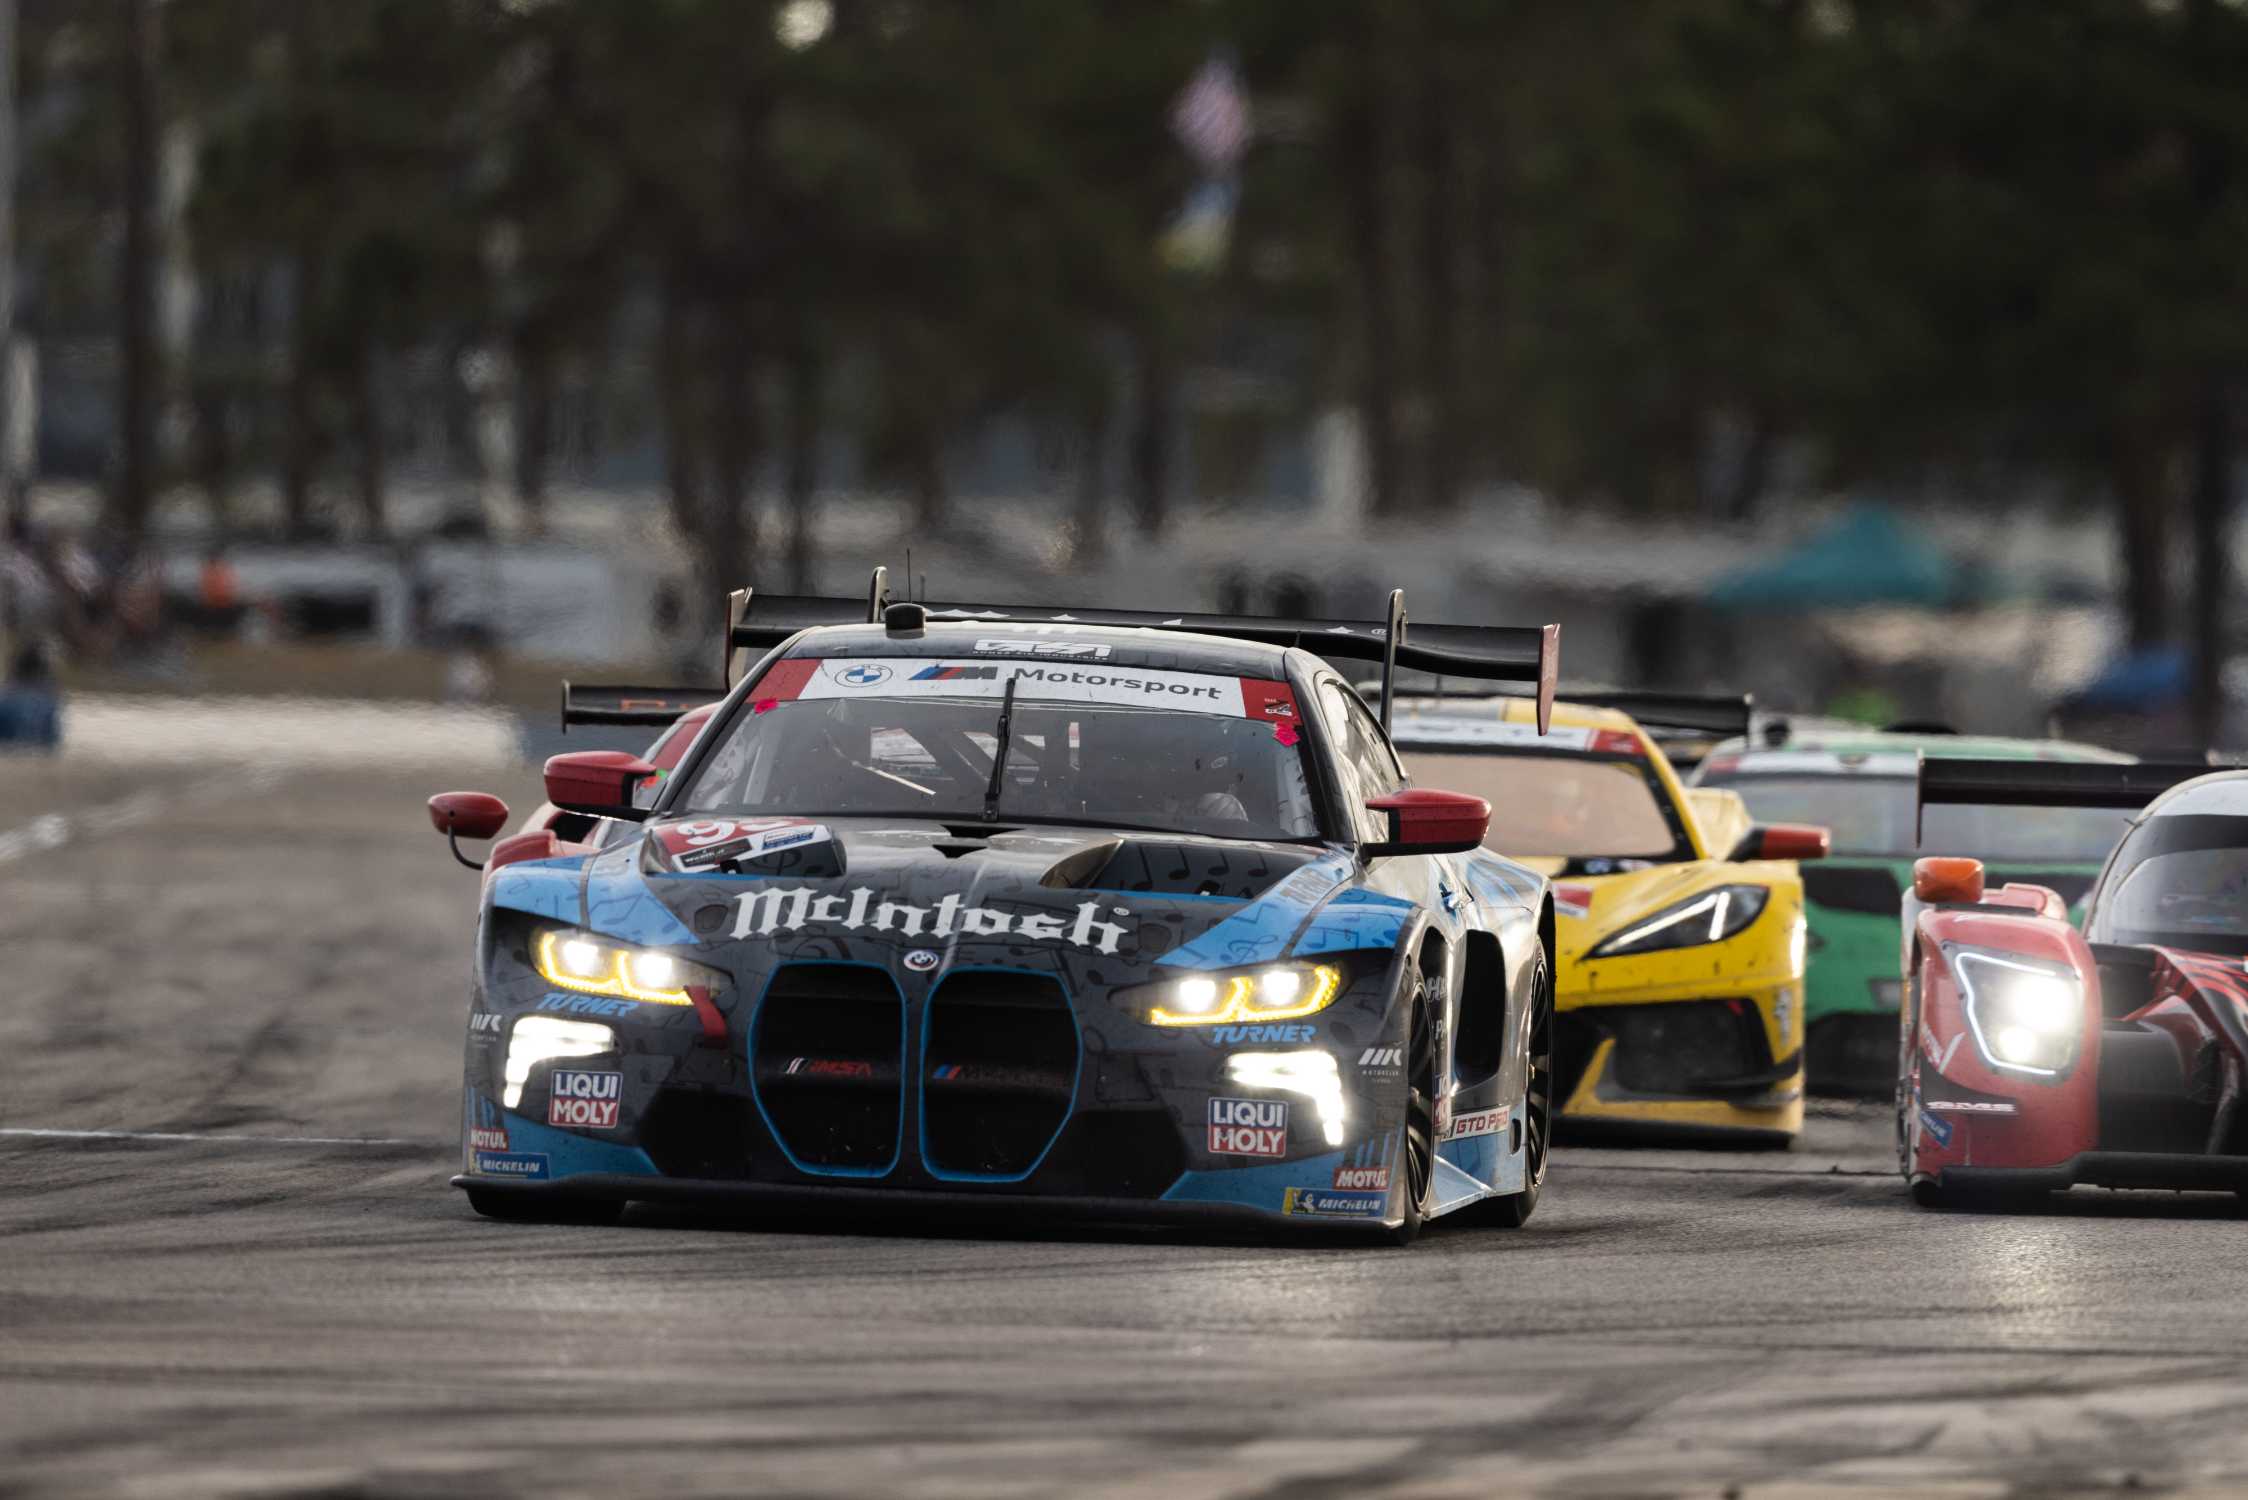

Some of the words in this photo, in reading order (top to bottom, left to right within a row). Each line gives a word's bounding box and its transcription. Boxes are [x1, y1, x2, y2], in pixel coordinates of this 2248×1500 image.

[1013, 667, 1222, 700] Motorsport
[729, 886, 1128, 955] McIntosh
[536, 992, 639, 1017] TURNER
[1212, 1024, 1317, 1044] TURNER
[555, 1073, 619, 1099] LIQUI
[553, 1099, 617, 1125] MOLY
[1213, 1101, 1284, 1127] LIQUI
[1456, 1117, 1486, 1134] GTD
[471, 1129, 507, 1149] MOTUL
[1212, 1127, 1285, 1153] MOLY
[482, 1159, 541, 1173] MICHELIN
[1336, 1170, 1387, 1188] MOTUL
[1318, 1198, 1381, 1211] MICHELIN
